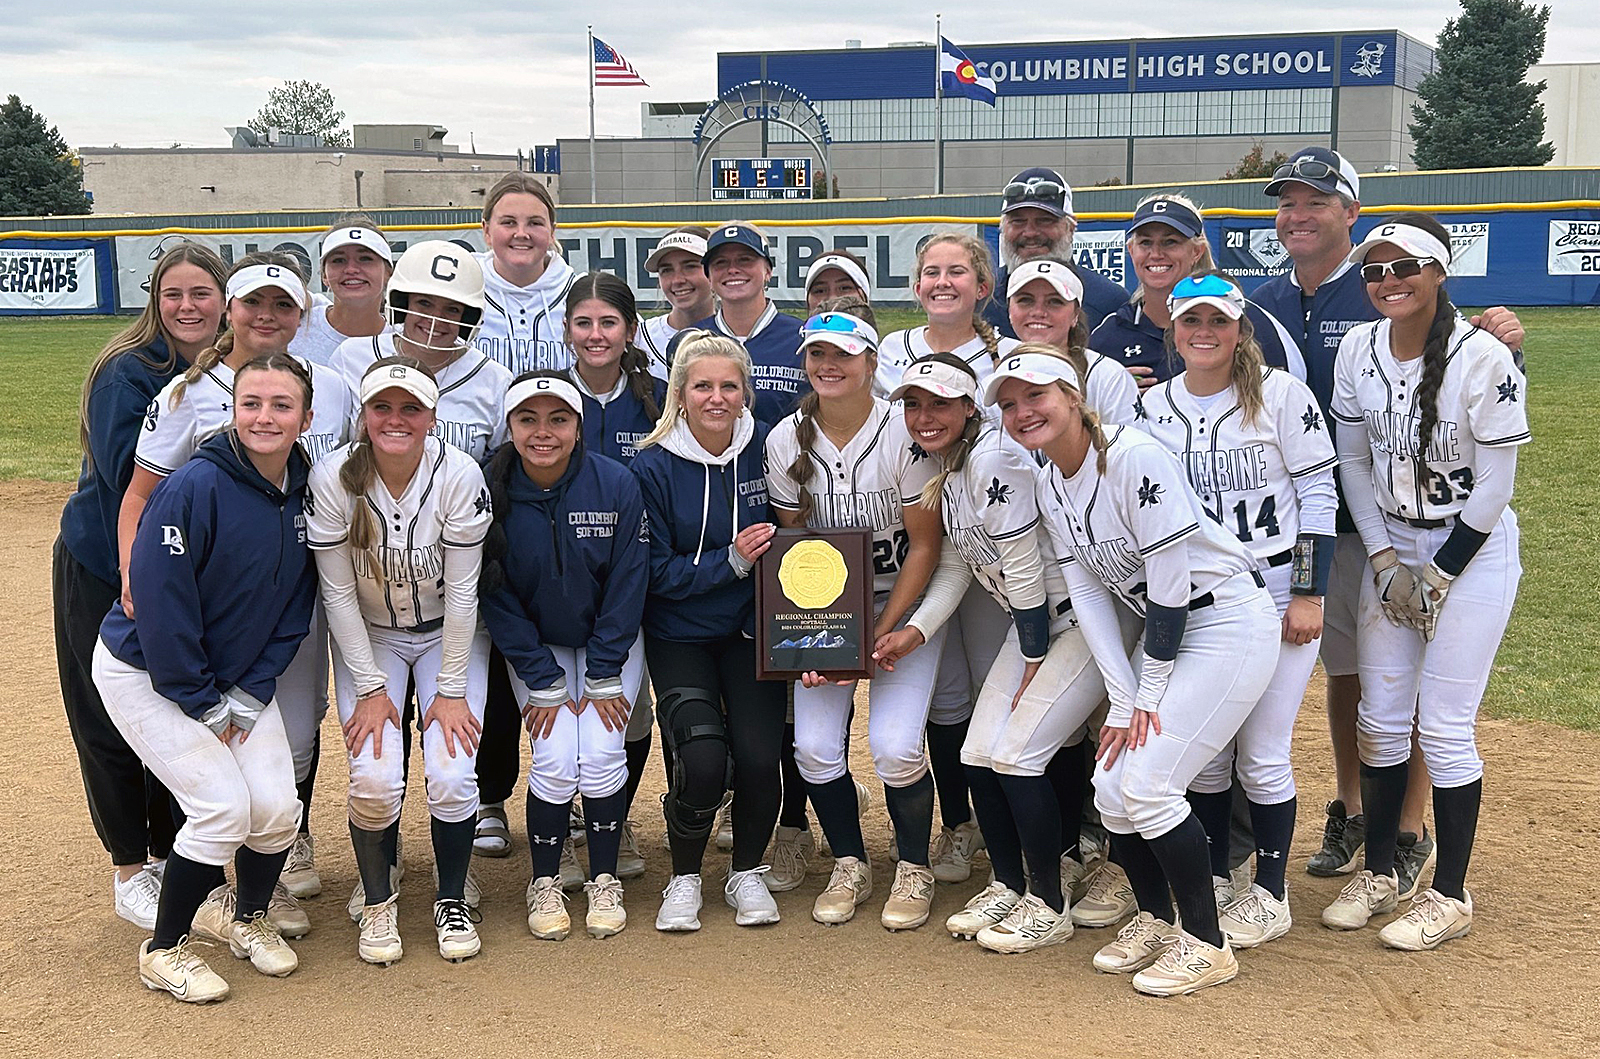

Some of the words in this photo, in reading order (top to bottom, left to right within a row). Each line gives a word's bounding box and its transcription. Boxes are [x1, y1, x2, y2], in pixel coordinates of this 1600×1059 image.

[1137, 54, 1204, 79] HIGH
[1214, 50, 1331, 76] SCHOOL
[743, 106, 780, 119] CHS
[720, 160, 737, 169] HOME
[784, 159, 806, 170] GUESTS
[723, 169, 739, 187] 18
[756, 169, 767, 187] 5
[715, 190, 728, 199] BALL
[749, 189, 769, 199] STRIKE
[786, 189, 798, 198] OUT
[1153, 201, 1168, 213] C
[349, 230, 361, 240] C
[724, 226, 738, 238] C
[1380, 226, 1395, 237] C
[1226, 231, 1244, 249] 20
[266, 266, 280, 278] C
[431, 255, 459, 282] C
[1037, 263, 1051, 274] C
[0, 275, 78, 293] CHAMPS
[919, 364, 933, 375] C
[1008, 358, 1021, 371] C
[389, 366, 407, 379] C
[750, 365, 806, 381] COLUMBINE
[536, 380, 550, 390] C
[755, 379, 798, 393] SOFTBALL
[1232, 494, 1281, 543] 14
[775, 613, 813, 621] REGIONAL
[813, 612, 853, 620] CHAMPION
